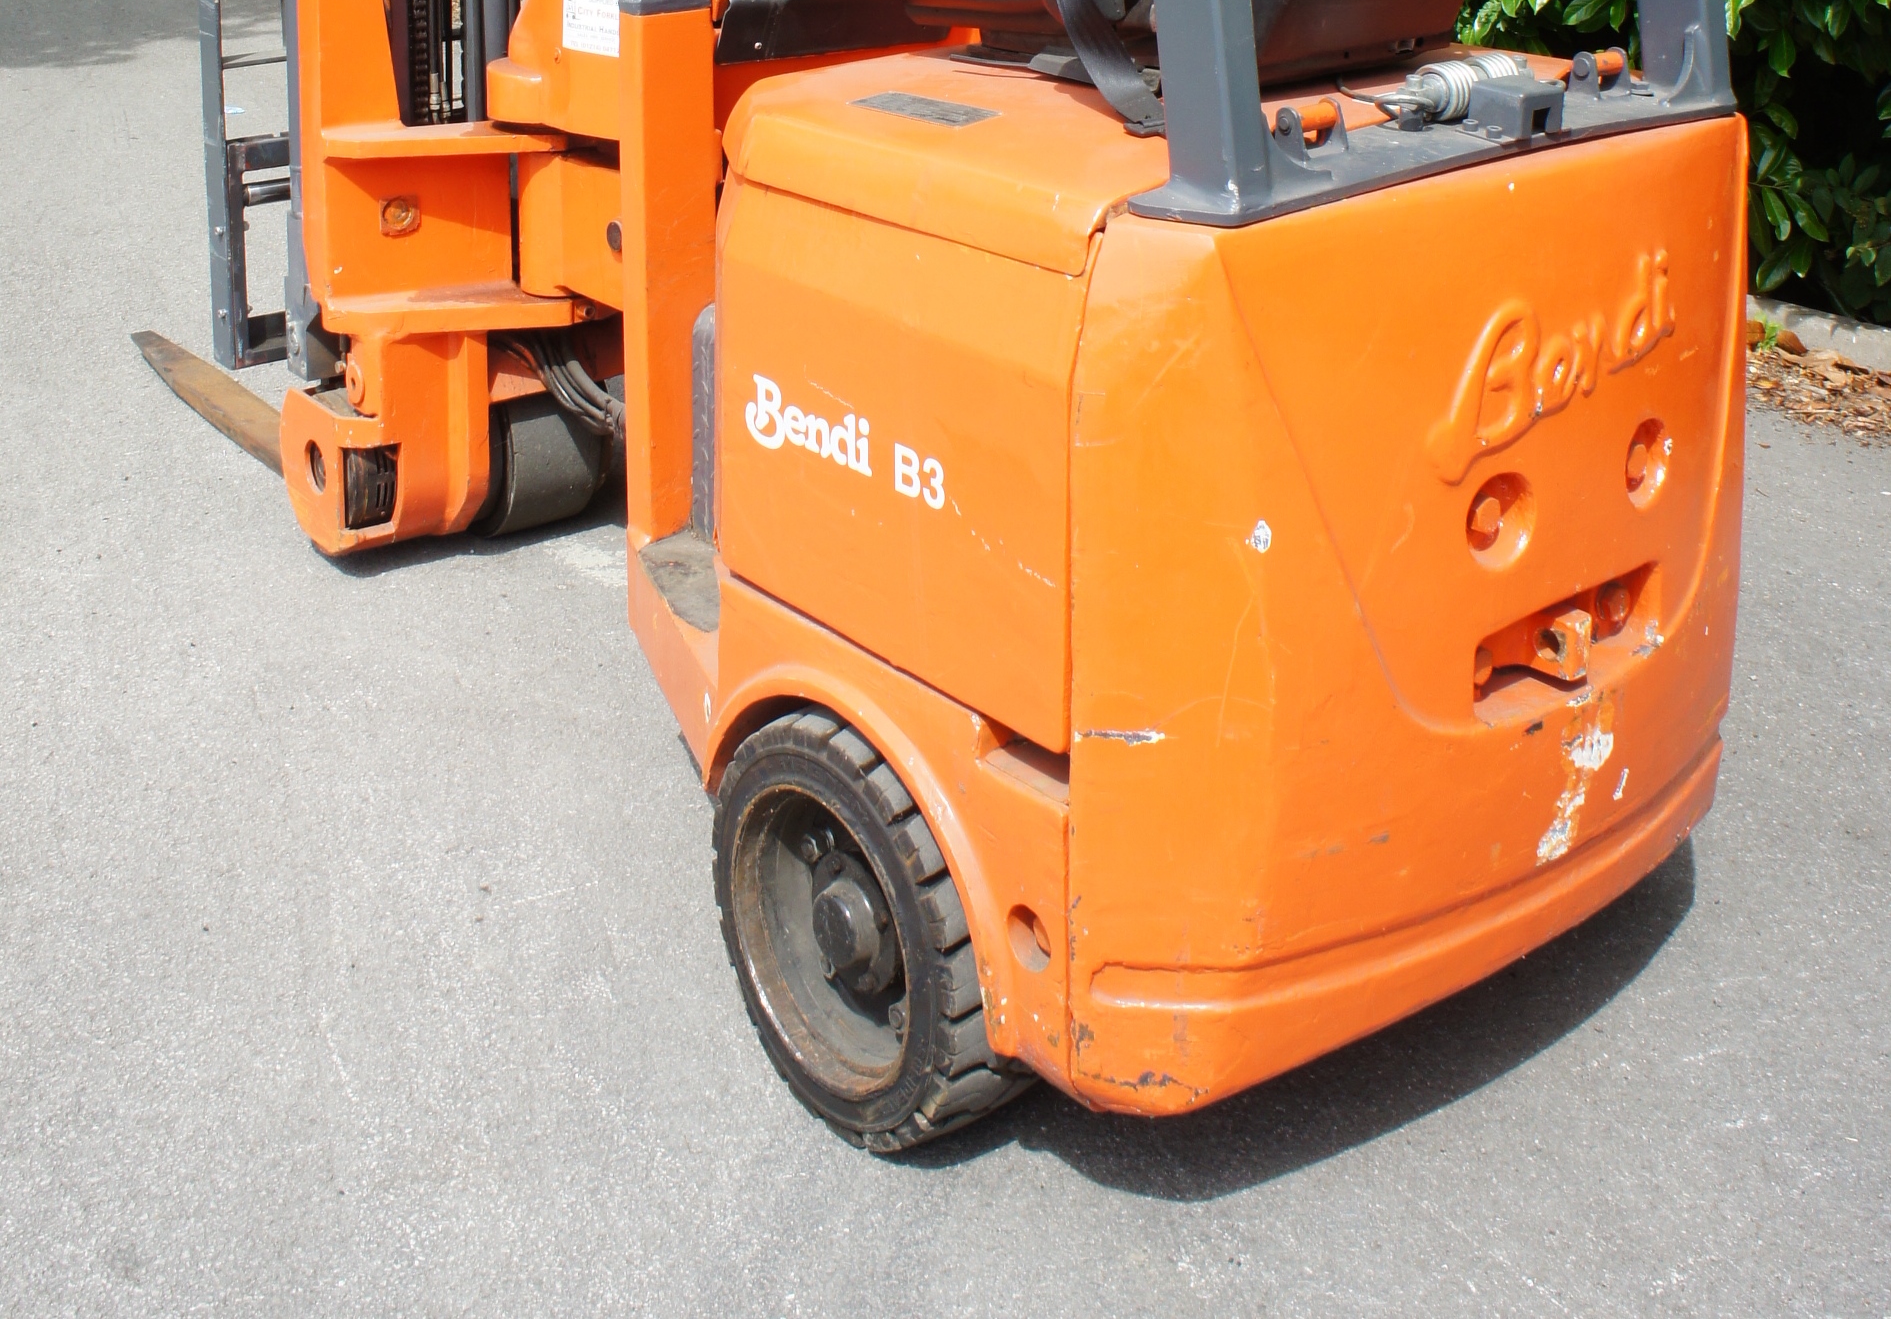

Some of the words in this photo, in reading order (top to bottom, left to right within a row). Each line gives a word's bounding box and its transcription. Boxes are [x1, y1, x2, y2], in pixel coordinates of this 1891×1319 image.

[745, 373, 873, 477] Bendi
[894, 442, 946, 510] B3
[1427, 246, 1676, 485] Bendi
